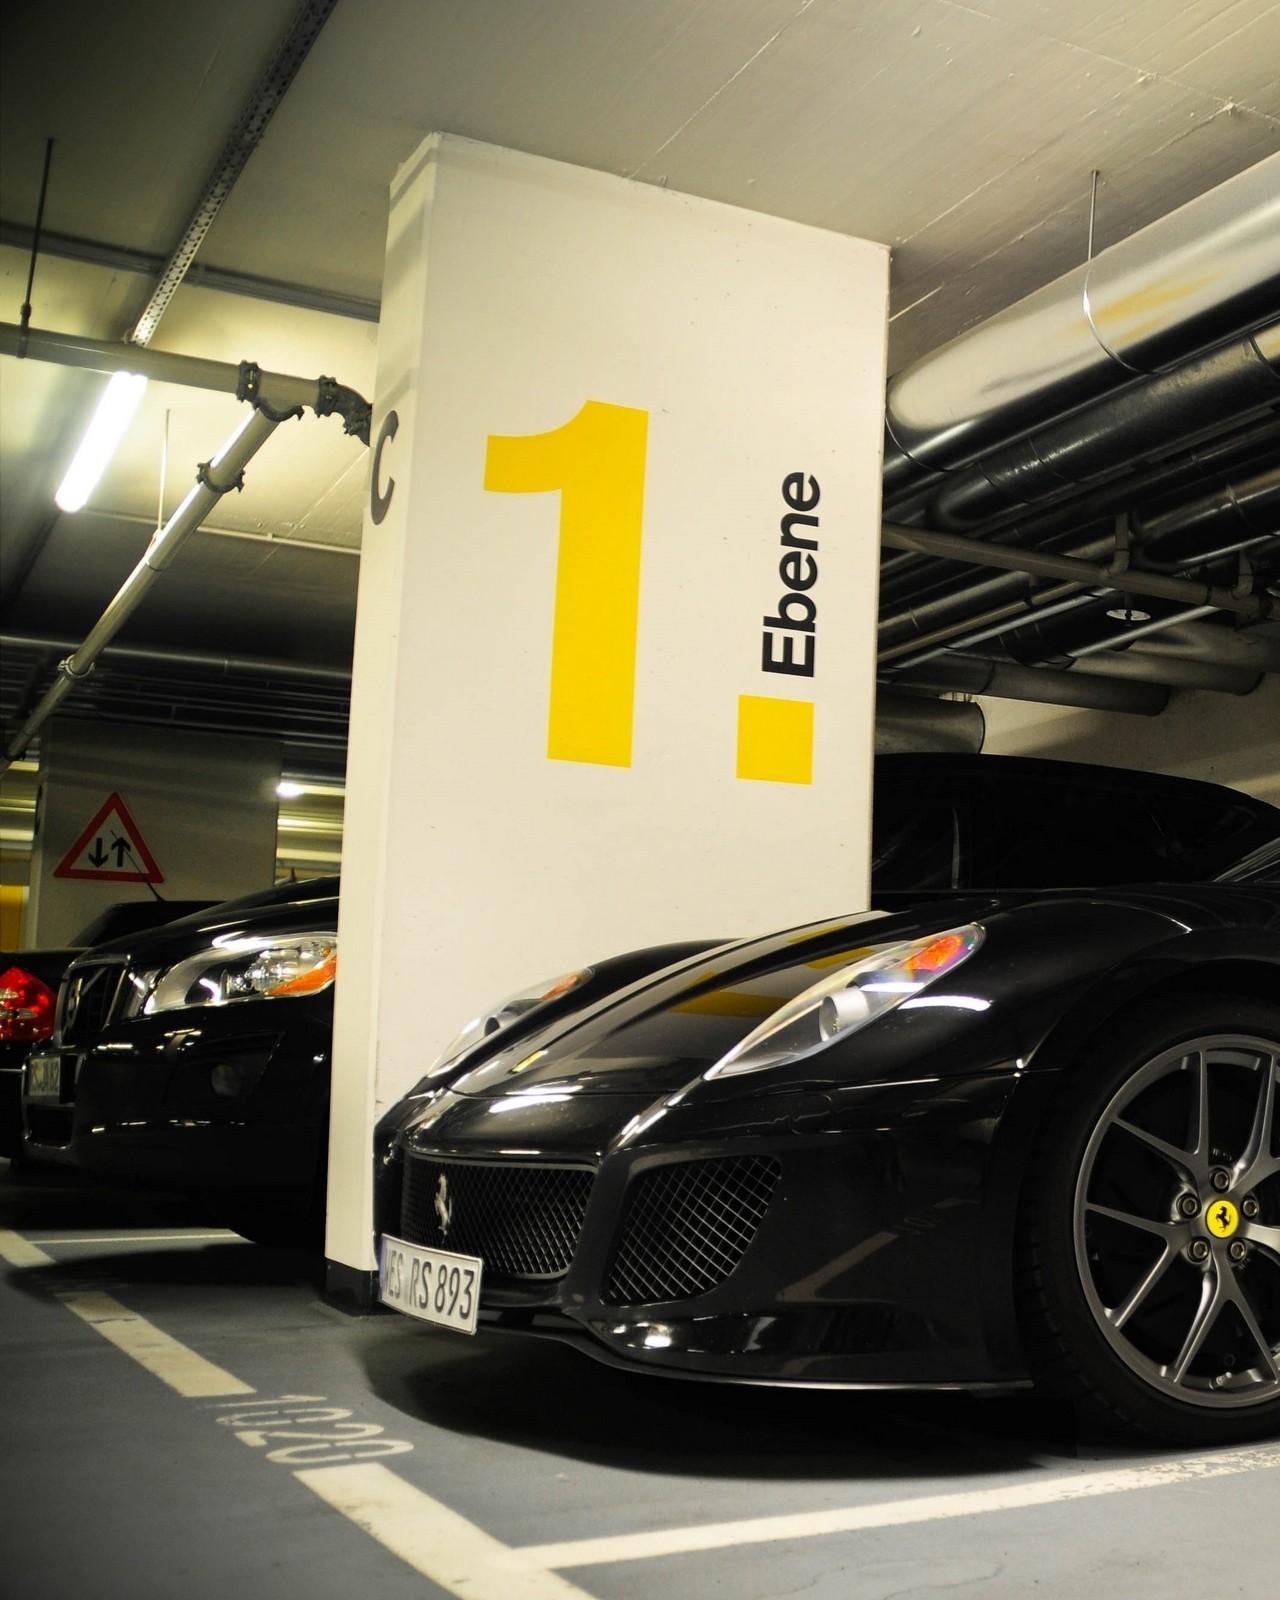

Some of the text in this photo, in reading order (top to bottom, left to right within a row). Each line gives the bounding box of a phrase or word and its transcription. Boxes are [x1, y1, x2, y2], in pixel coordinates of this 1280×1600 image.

[371, 410, 399, 526] C
[762, 471, 820, 678] Ebene
[410, 1258, 432, 1309] RS
[435, 1264, 475, 1320] 893
[203, 1394, 414, 1463] 1020
